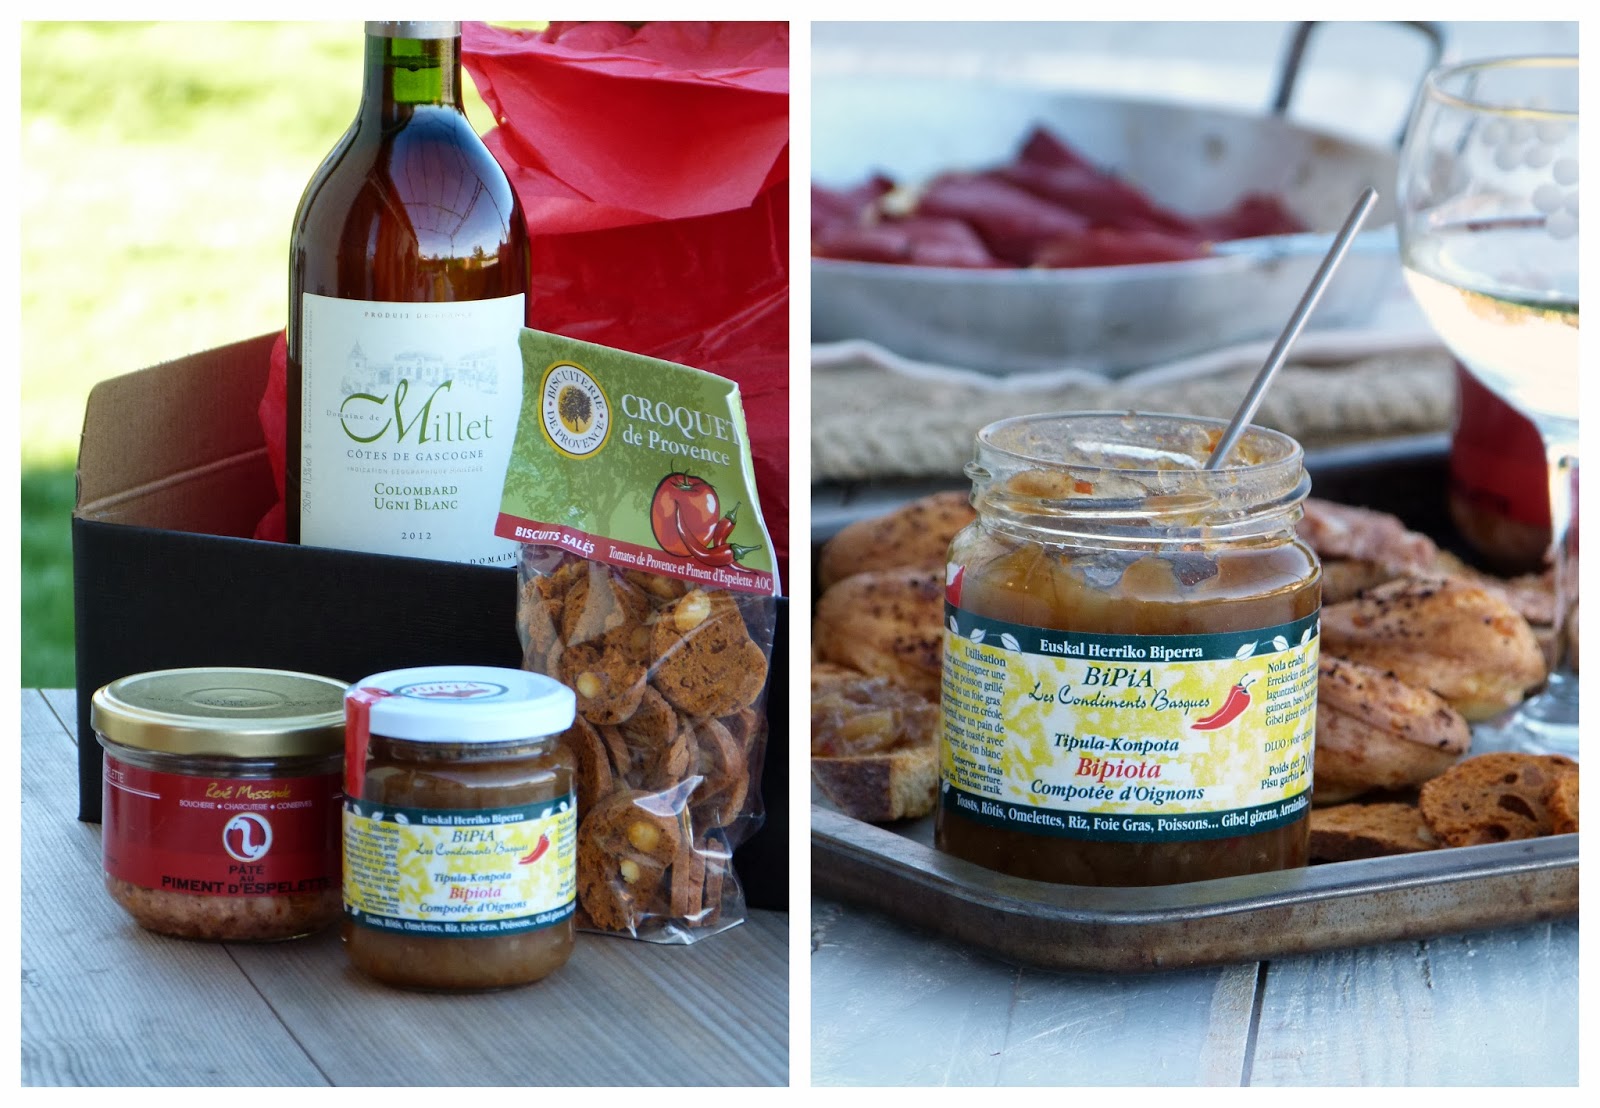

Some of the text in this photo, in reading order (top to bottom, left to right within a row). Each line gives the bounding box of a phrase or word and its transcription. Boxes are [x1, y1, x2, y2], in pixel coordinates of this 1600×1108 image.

[364, 311, 409, 319] PRODUIT
[548, 370, 604, 411] BISCUITERIE
[326, 409, 380, 421] Domaine de
[340, 378, 493, 445] Millet
[546, 410, 605, 449] DE PROVENCE
[623, 424, 730, 467] de Provence
[346, 449, 484, 461] CÔTES DE GASCOGNE
[346, 467, 388, 475] INDICATION
[401, 532, 432, 540] 2012
[515, 526, 561, 541] BISCUITS
[609, 546, 772, 591] Tomates de Provence et Piment d'Espelette AOC
[965, 647, 1006, 667] Utilisation
[1040, 639, 1203, 661] Euskal Herriko Biperra
[1267, 660, 1286, 674] Nola
[991, 670, 1006, 680] une
[1082, 666, 1153, 687] BiPiA
[1028, 681, 1210, 716] Les Condiments Basques
[977, 720, 993, 731] pain
[994, 722, 1005, 733] de
[1265, 712, 1284, 726] Gibel
[986, 737, 1005, 747] avec
[1054, 733, 1179, 756] Tipula-Konpota
[1264, 738, 1286, 753] DLUO
[1075, 757, 1161, 784] Bipiota
[1269, 758, 1300, 776] Poids net
[1260, 771, 1300, 790] Pisu garbia
[1031, 779, 1205, 806] Compotée d'Oignons
[179, 800, 312, 811] BOUCHERIE CHARCUTERIE CONSERVES
[957, 793, 980, 813] Toasts,
[981, 801, 1006, 820] Rôtis,
[1008, 807, 1065, 829] Omelettes,
[1068, 815, 1090, 832] Riz,
[1093, 817, 1119, 831] Foie
[1122, 819, 1154, 833] Gras,
[1157, 817, 1219, 832] Poissons...
[1221, 811, 1248, 828] Gibel
[1250, 808, 1279, 827] gizena,
[421, 813, 524, 826] Euskal Herriko Biperra
[451, 829, 495, 843] BiPiA
[415, 841, 528, 858] Les Condiments Basques
[228, 862, 264, 875] PÂTÉ
[161, 875, 225, 894] PIMENT
[239, 875, 255, 883] AU
[434, 872, 512, 886] Tipula-Konpota
[449, 887, 502, 903] Bipiota
[419, 900, 527, 915] Compotée d'Oignons
[461, 922, 478, 932] Foie
